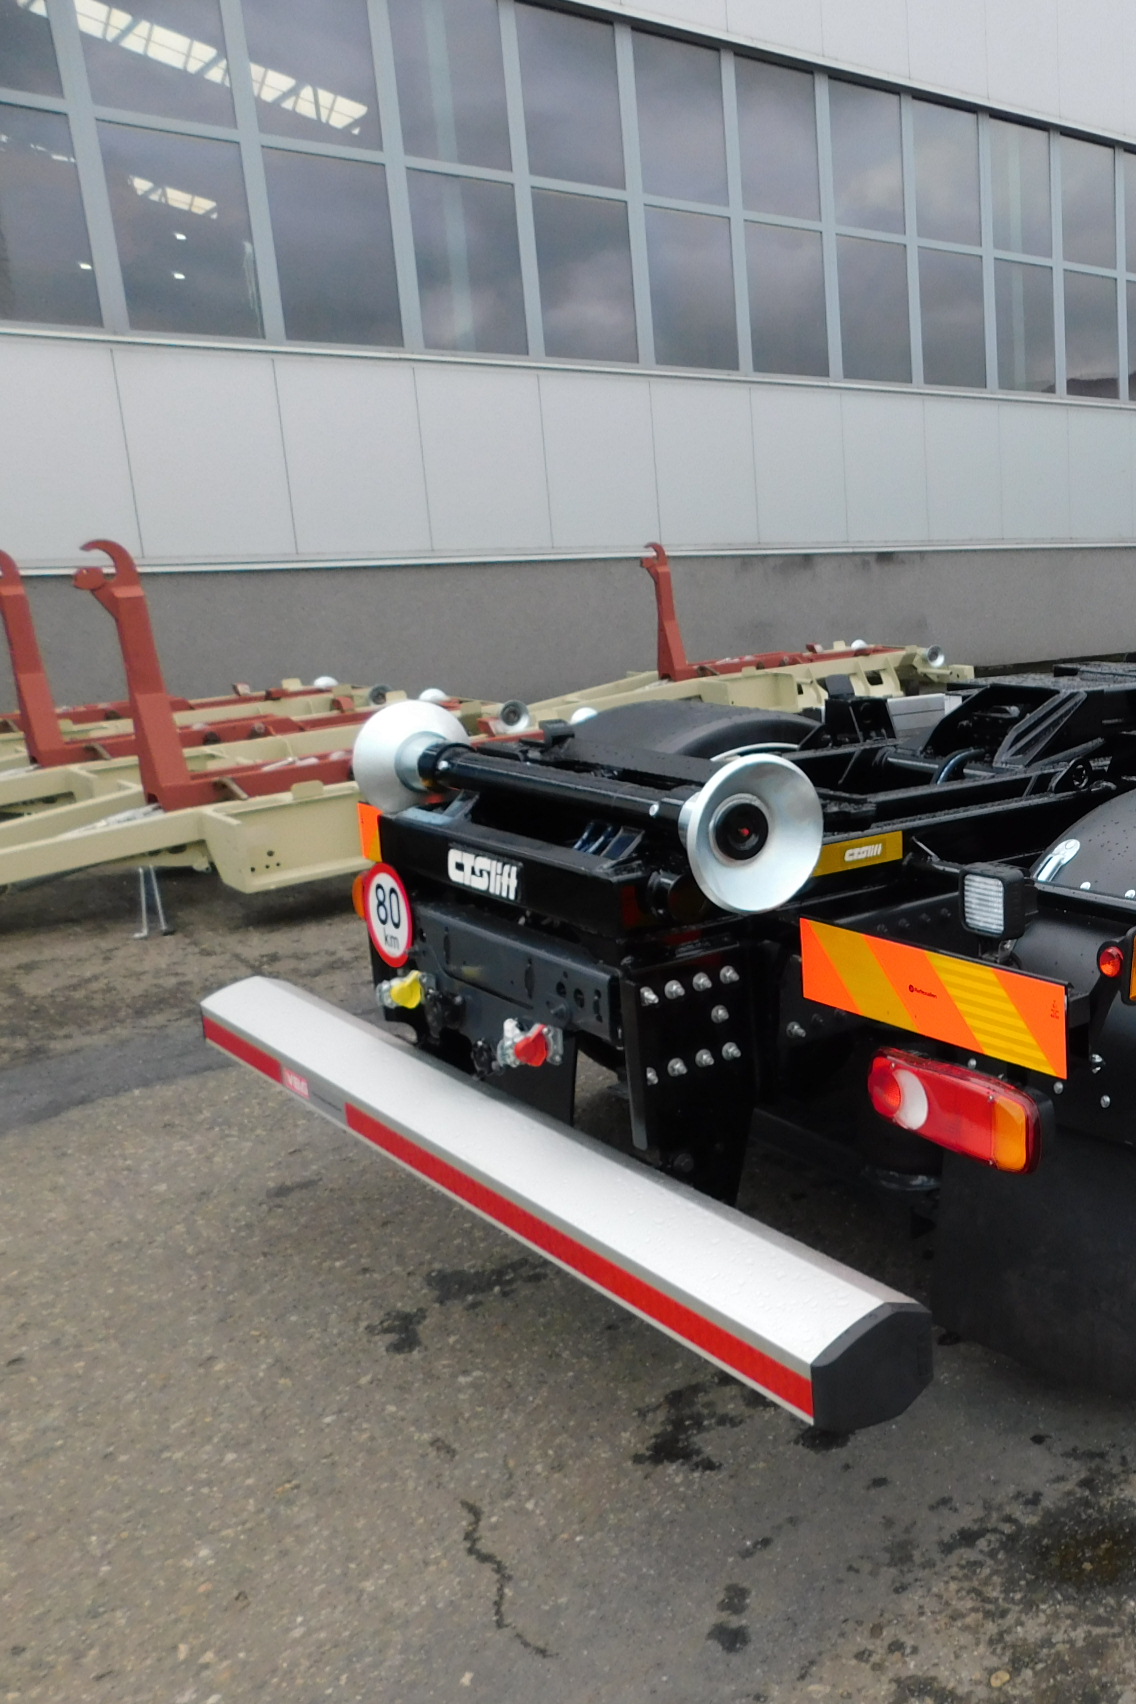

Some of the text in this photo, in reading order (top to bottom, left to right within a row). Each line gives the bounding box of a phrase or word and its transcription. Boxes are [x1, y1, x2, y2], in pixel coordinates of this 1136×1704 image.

[448, 848, 518, 900] CTSlift
[375, 883, 401, 929] 80
[383, 927, 400, 950] km
